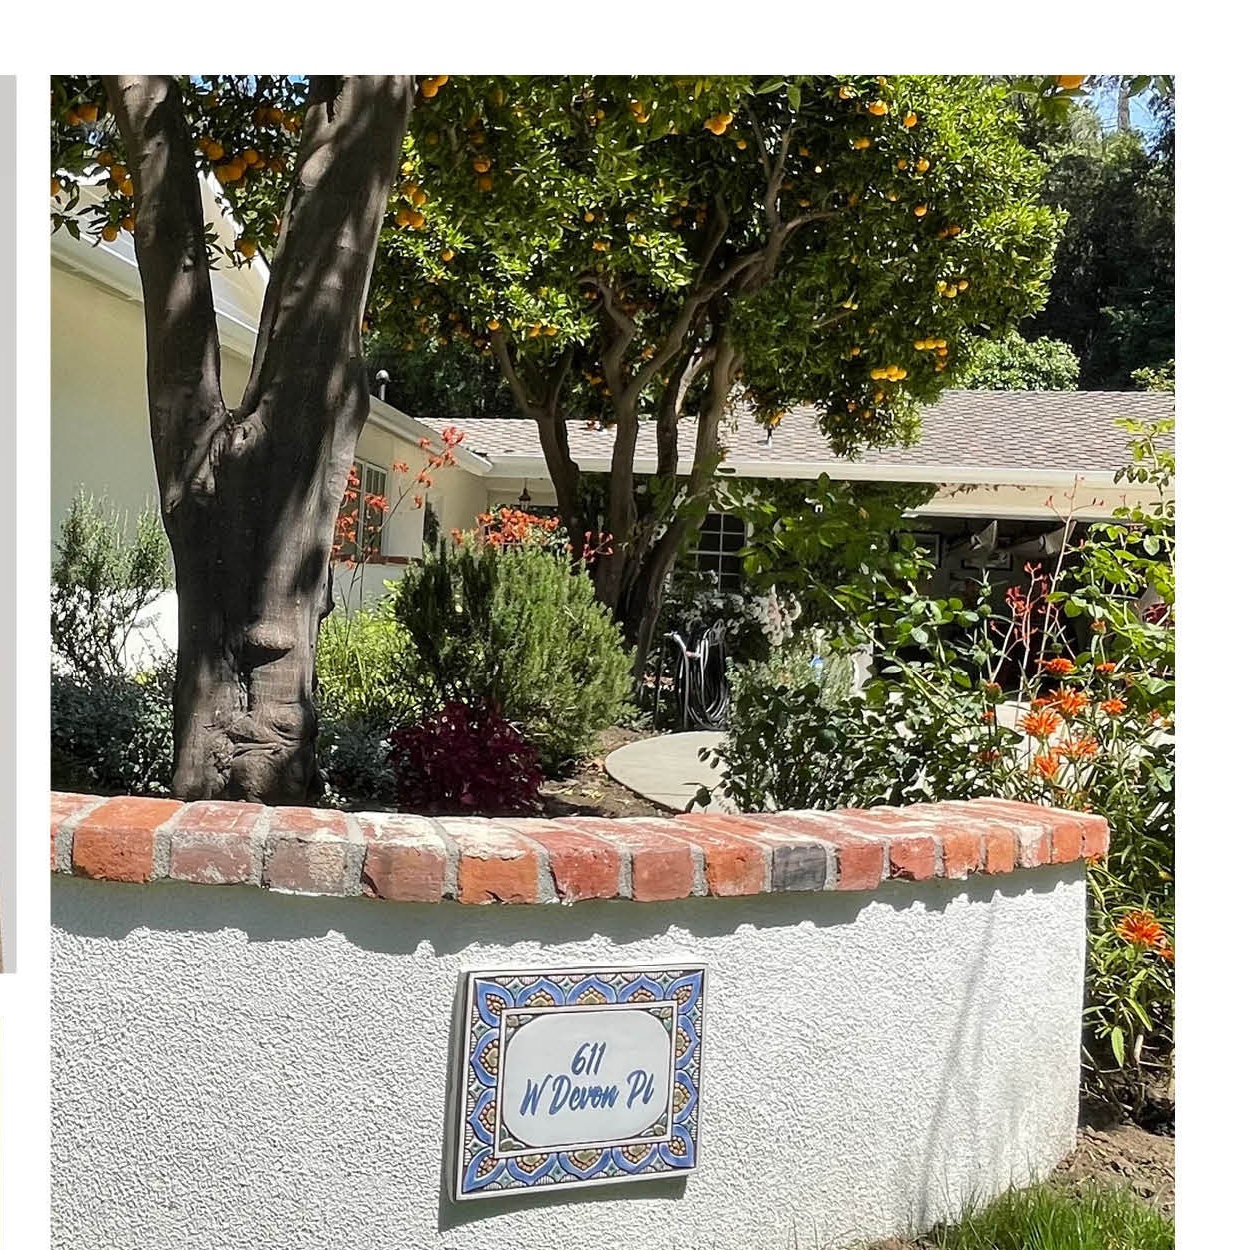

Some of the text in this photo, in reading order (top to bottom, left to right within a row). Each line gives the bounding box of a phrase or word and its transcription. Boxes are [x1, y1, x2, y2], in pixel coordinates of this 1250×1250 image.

[571, 1041, 607, 1076] 611
[519, 1069, 655, 1117] W Devon Pl
